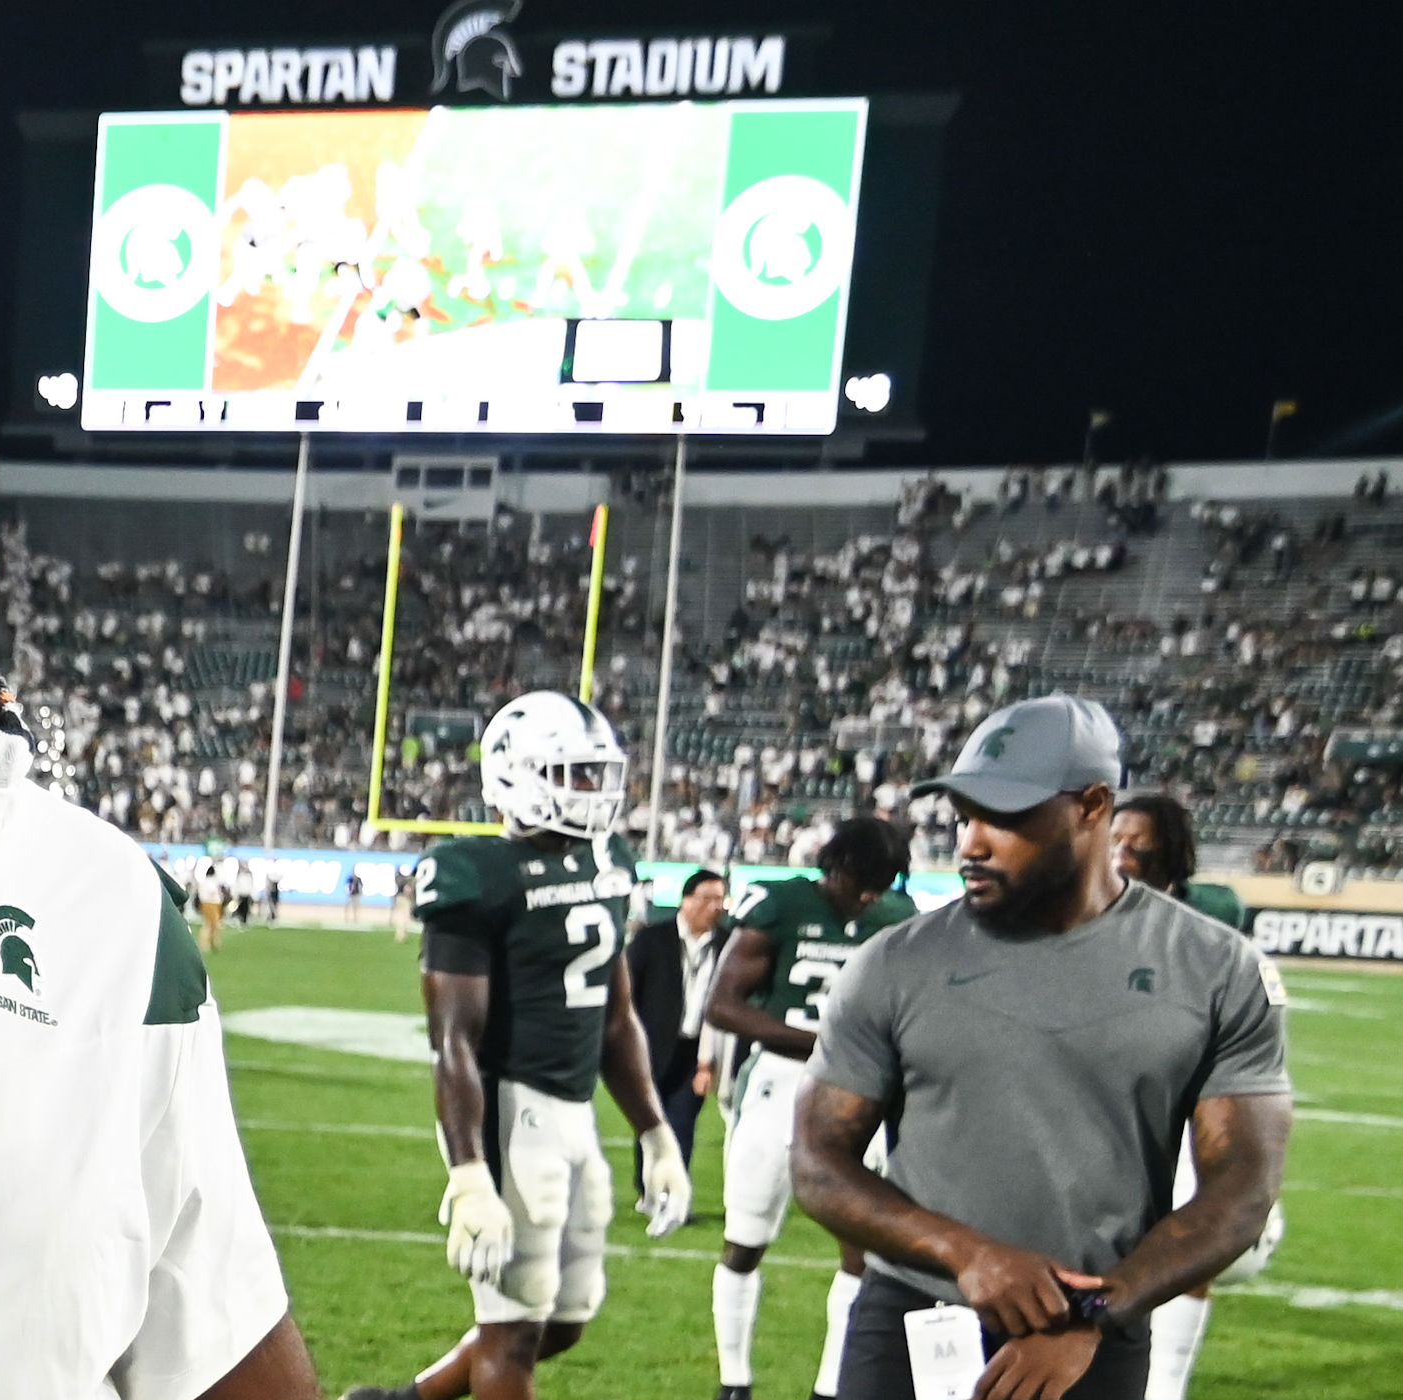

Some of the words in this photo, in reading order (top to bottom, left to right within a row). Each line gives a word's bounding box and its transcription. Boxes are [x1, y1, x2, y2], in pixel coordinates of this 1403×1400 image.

[181, 47, 396, 104] SPARTAN
[551, 35, 785, 96] STADIUM
[415, 857, 439, 906] 2
[564, 903, 617, 1009] 2
[1253, 909, 1403, 959] SPARTA
[19, 1003, 51, 1025] STATE
